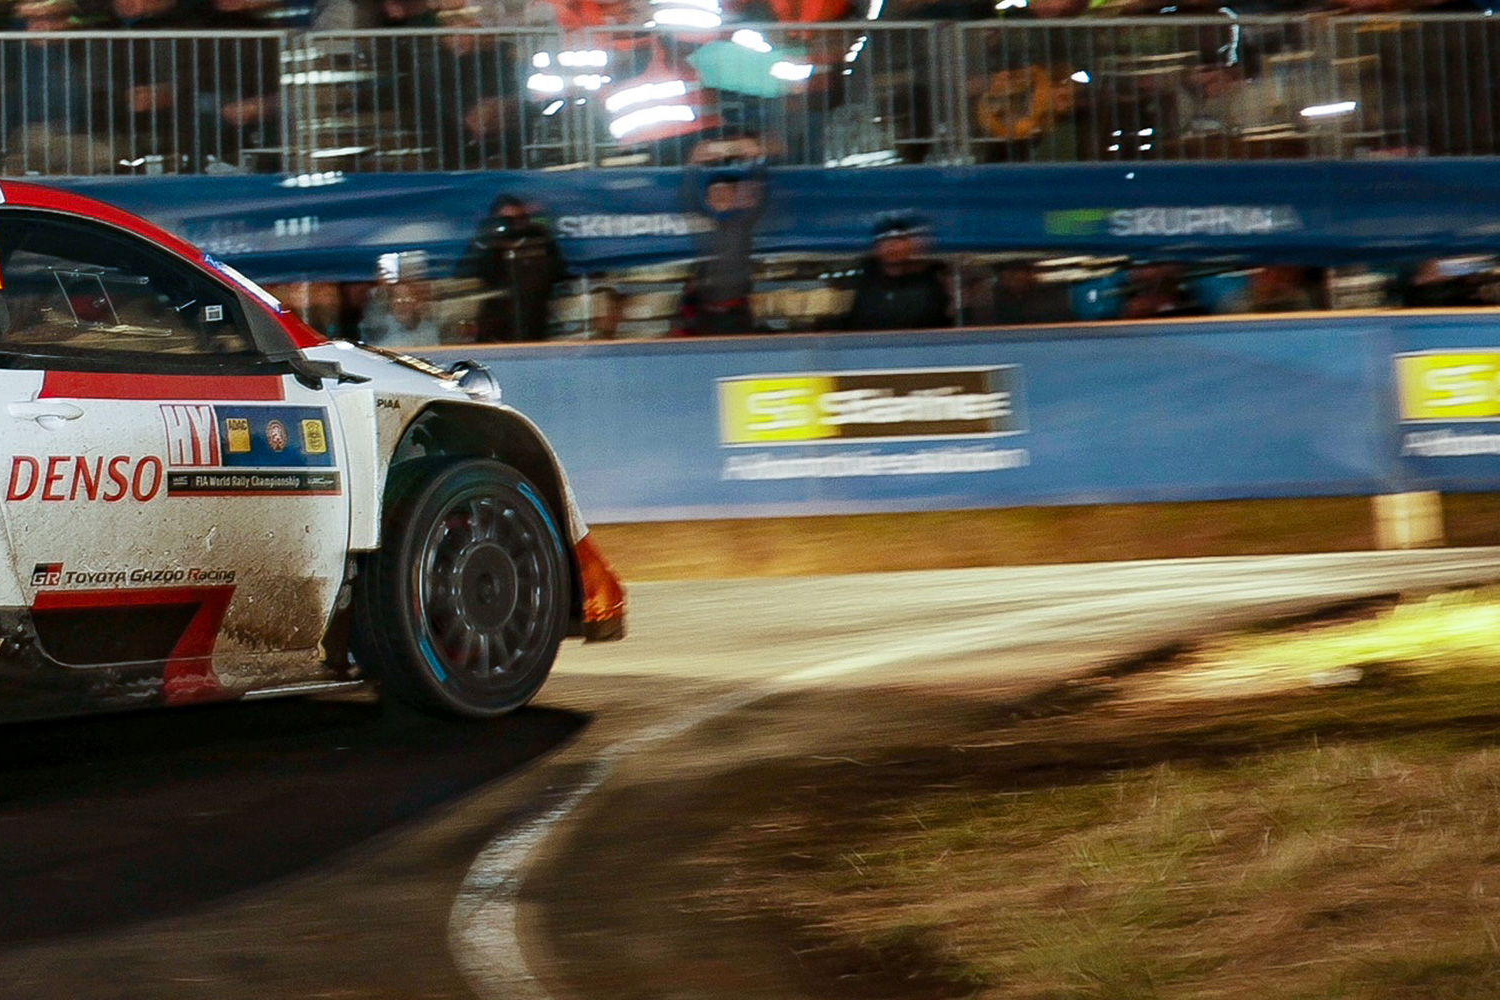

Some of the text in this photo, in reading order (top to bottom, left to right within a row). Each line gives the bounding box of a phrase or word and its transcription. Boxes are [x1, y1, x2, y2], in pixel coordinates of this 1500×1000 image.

[376, 398, 401, 409] PIAA
[161, 405, 215, 465] HY
[6, 455, 164, 502] DENSO
[195, 476, 208, 487] FIA
[209, 476, 230, 487] World
[232, 475, 250, 488] Rally
[251, 475, 300, 490] Championship
[32, 567, 236, 586] GR TOYOTA GAZOO Racing
